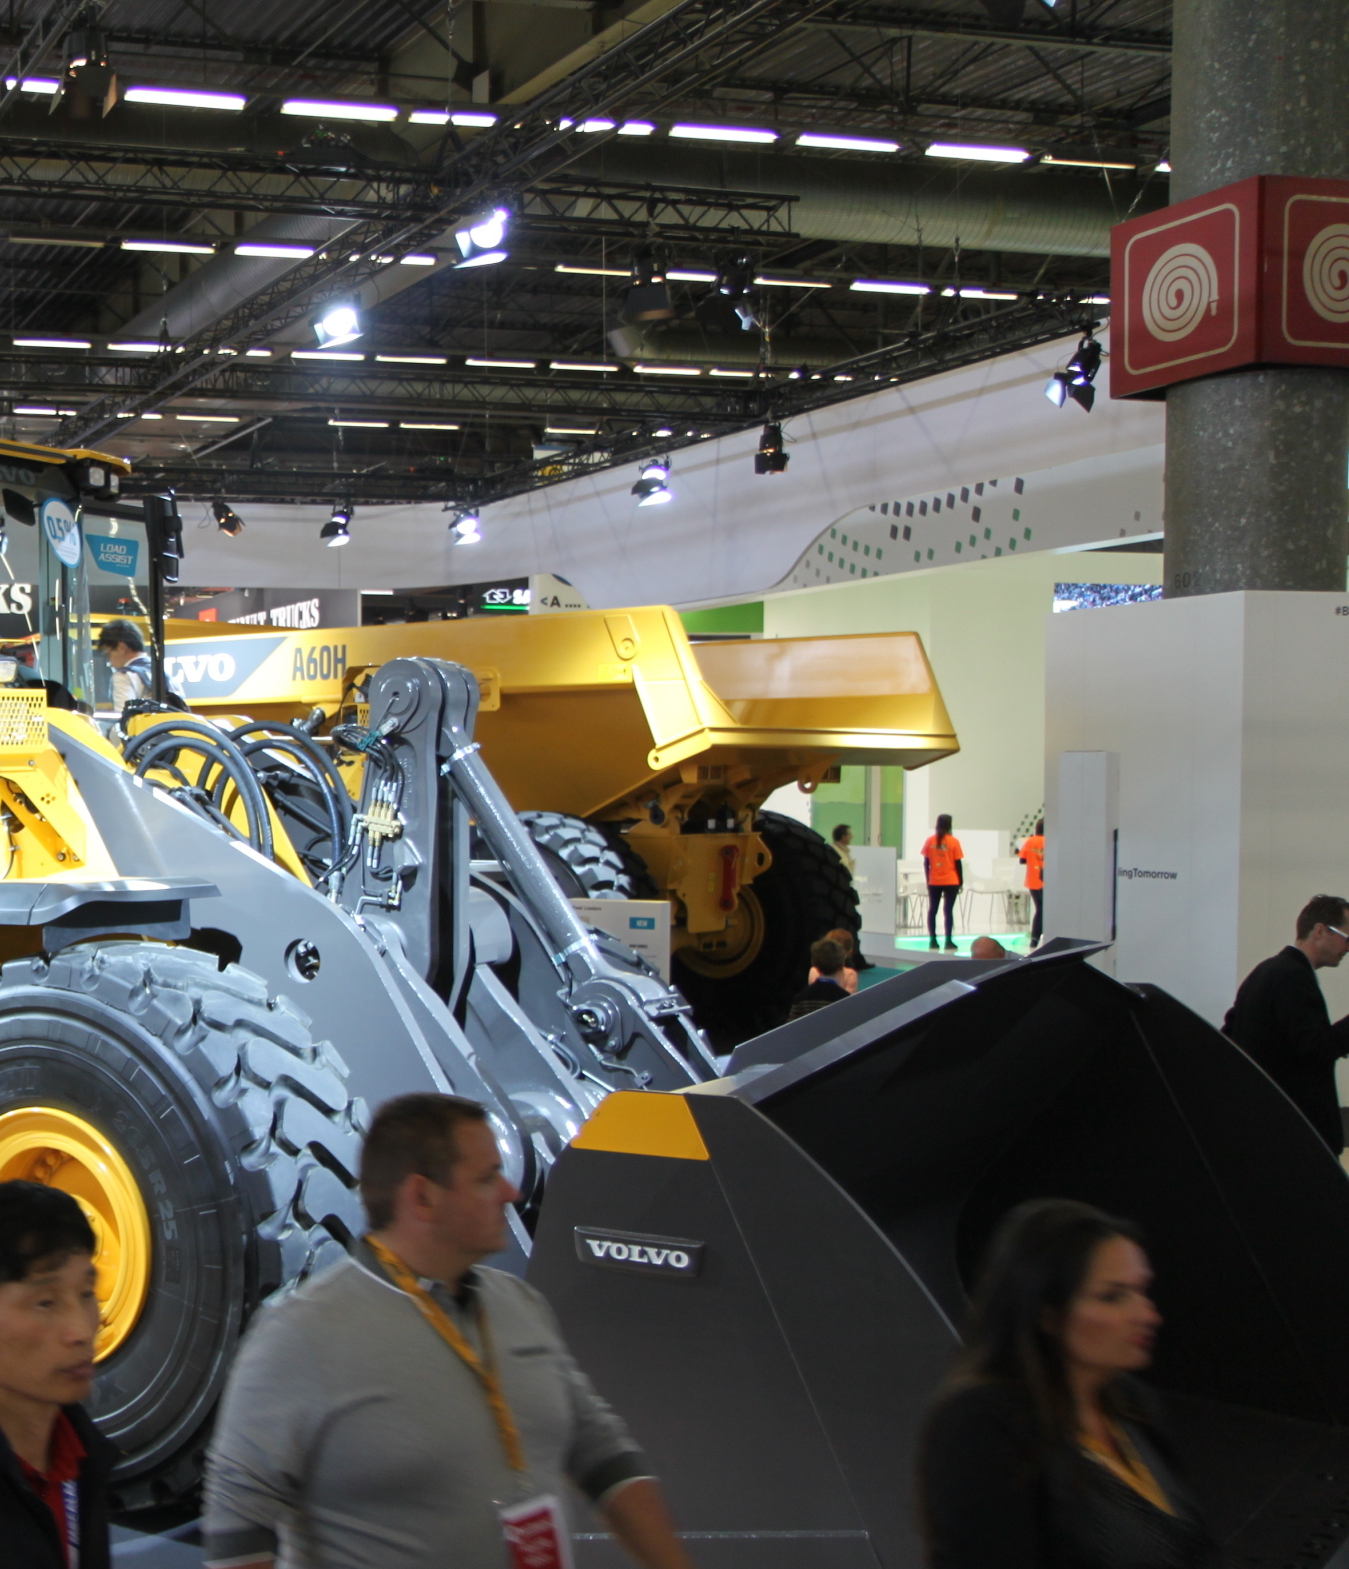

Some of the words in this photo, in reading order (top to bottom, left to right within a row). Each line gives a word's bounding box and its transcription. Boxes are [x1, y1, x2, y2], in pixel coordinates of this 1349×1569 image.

[98, 553, 133, 564] ASSIST
[100, 543, 127, 554] LOAD
[164, 653, 235, 683] LVO
[292, 644, 346, 681] A60H
[585, 1239, 689, 1268] VOLVO
